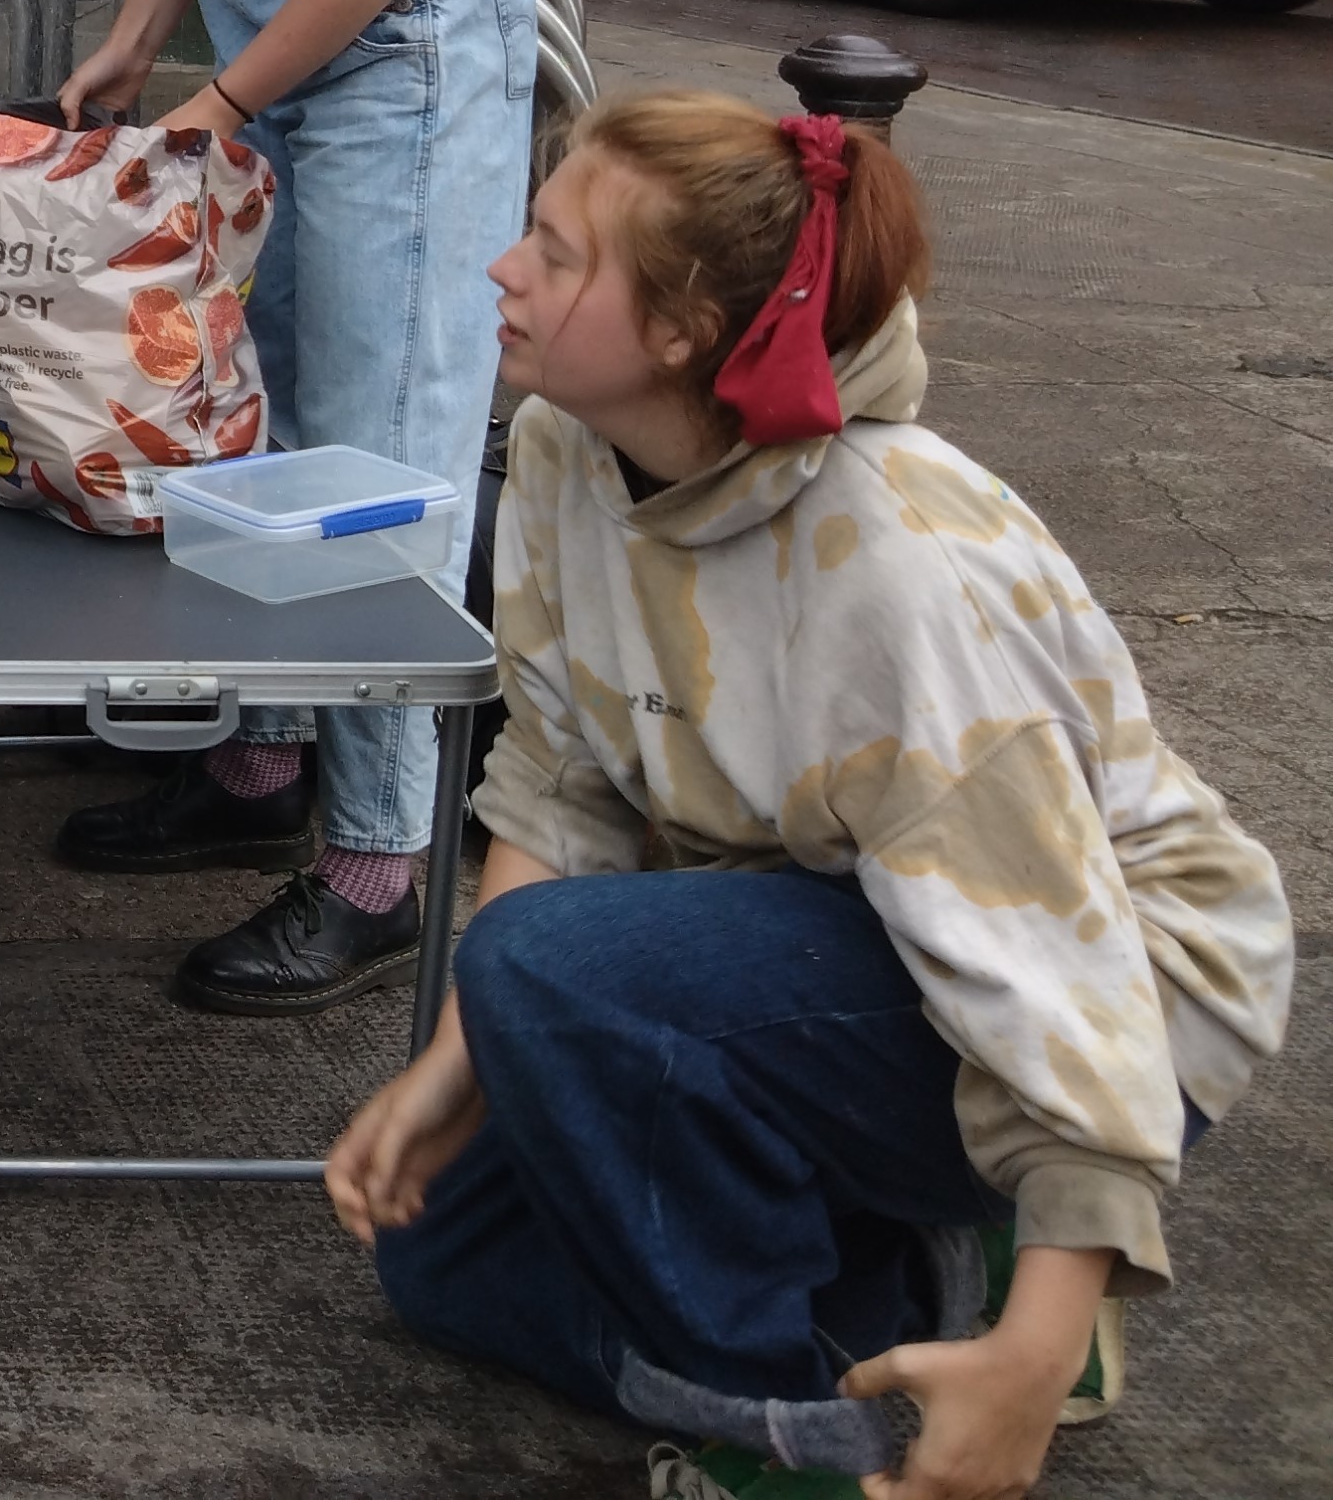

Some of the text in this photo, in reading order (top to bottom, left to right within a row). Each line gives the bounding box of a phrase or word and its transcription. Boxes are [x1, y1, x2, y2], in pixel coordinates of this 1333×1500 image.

[45, 235, 76, 273] is
[0, 344, 40, 358] plastic
[43, 348, 85, 362] waste.
[38, 365, 84, 381] recycle
[5, 377, 33, 392] free.
